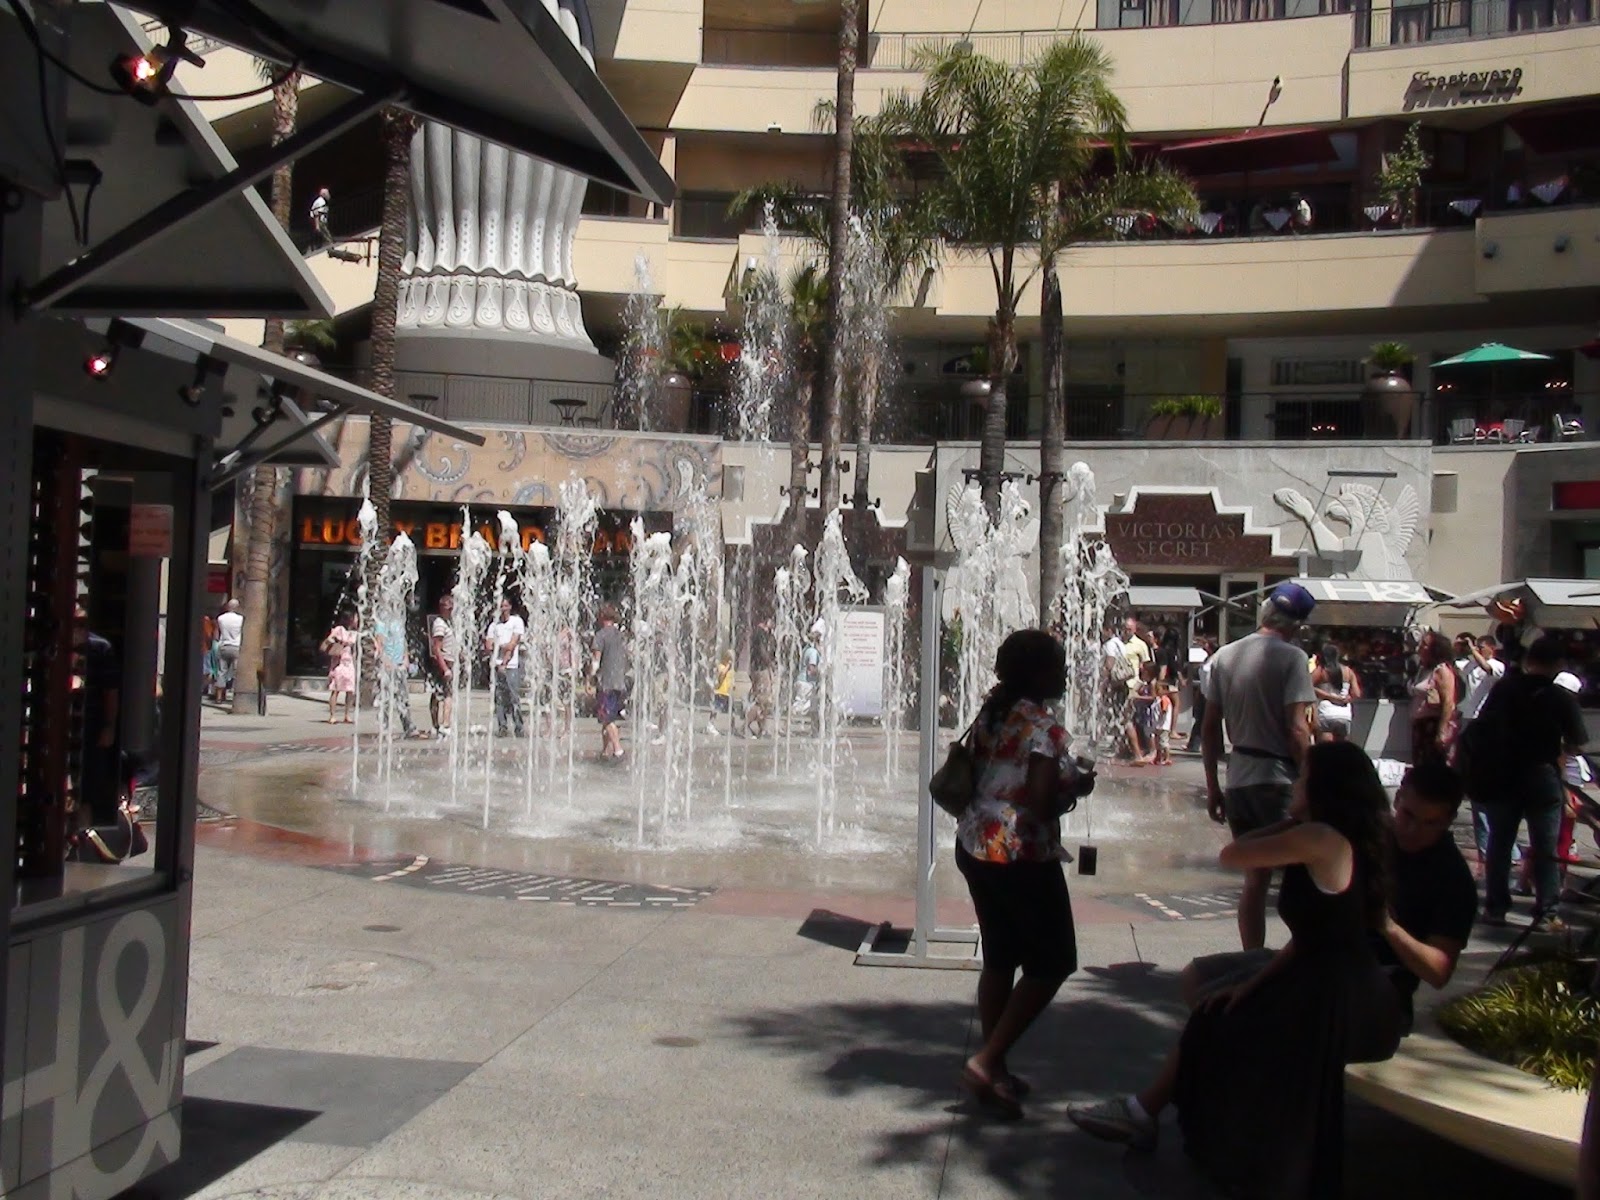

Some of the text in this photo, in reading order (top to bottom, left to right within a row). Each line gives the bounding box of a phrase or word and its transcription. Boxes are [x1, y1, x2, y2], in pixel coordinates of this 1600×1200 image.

[302, 517, 415, 545] LUCY
[1118, 521, 1237, 540] VICTORIA'S
[1137, 540, 1212, 557] SECRET
